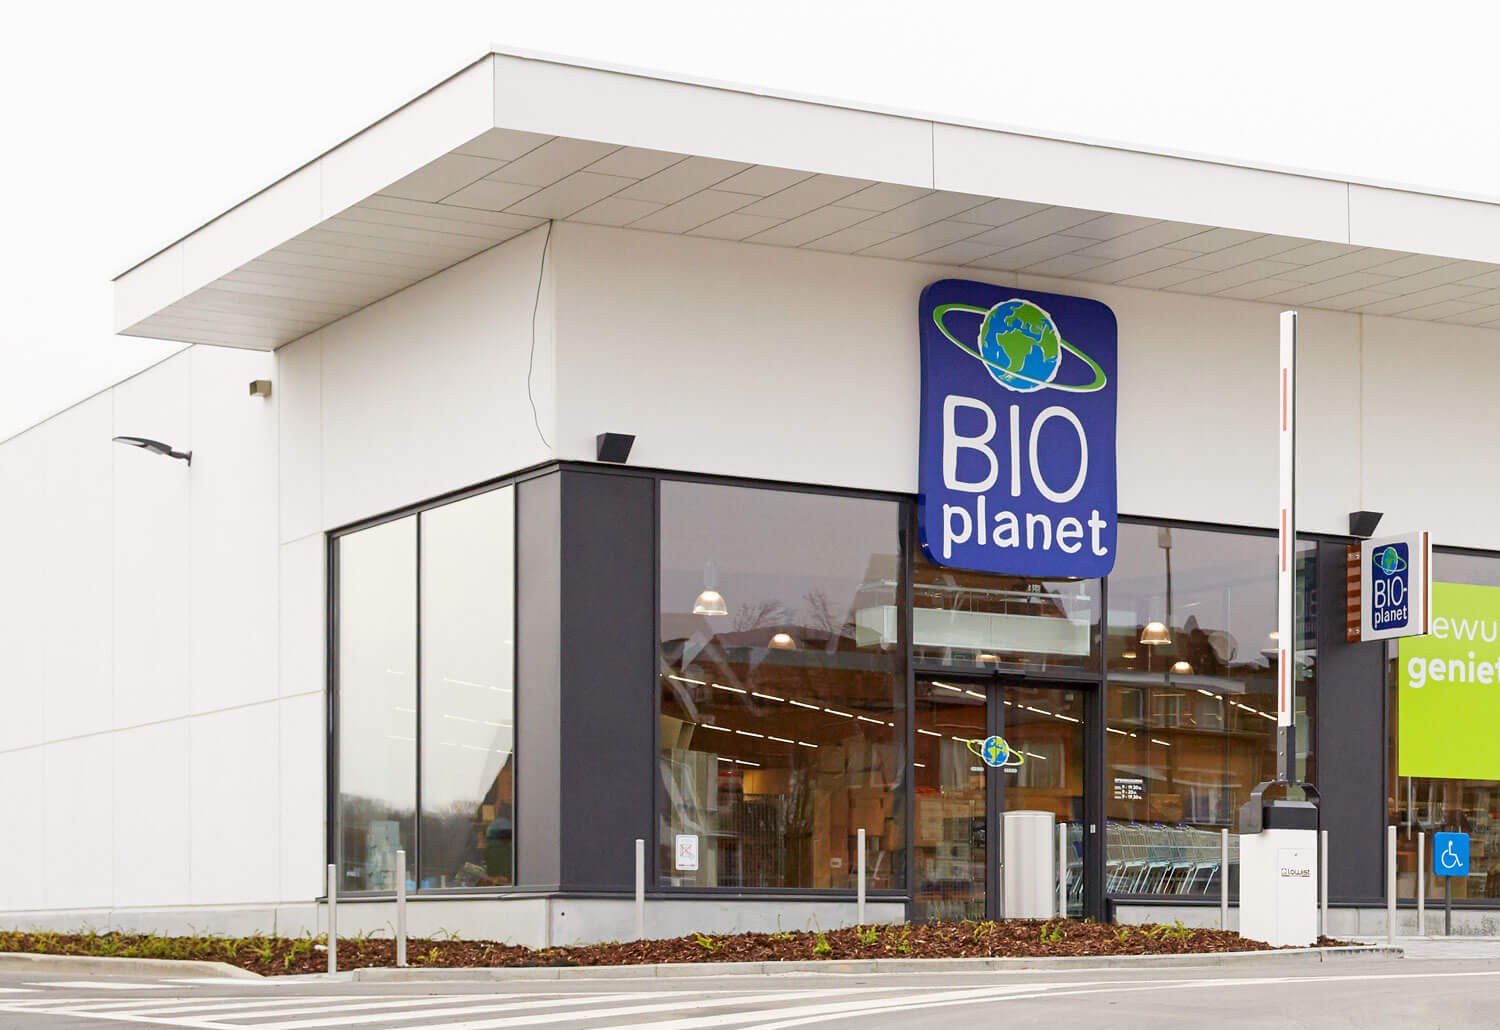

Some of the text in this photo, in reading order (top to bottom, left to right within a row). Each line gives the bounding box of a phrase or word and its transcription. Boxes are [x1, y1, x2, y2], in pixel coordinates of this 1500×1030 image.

[942, 394, 1088, 503] BIO
[942, 495, 1108, 559] planet
[1374, 576, 1408, 608] BIO-
[1374, 605, 1408, 629] planet
